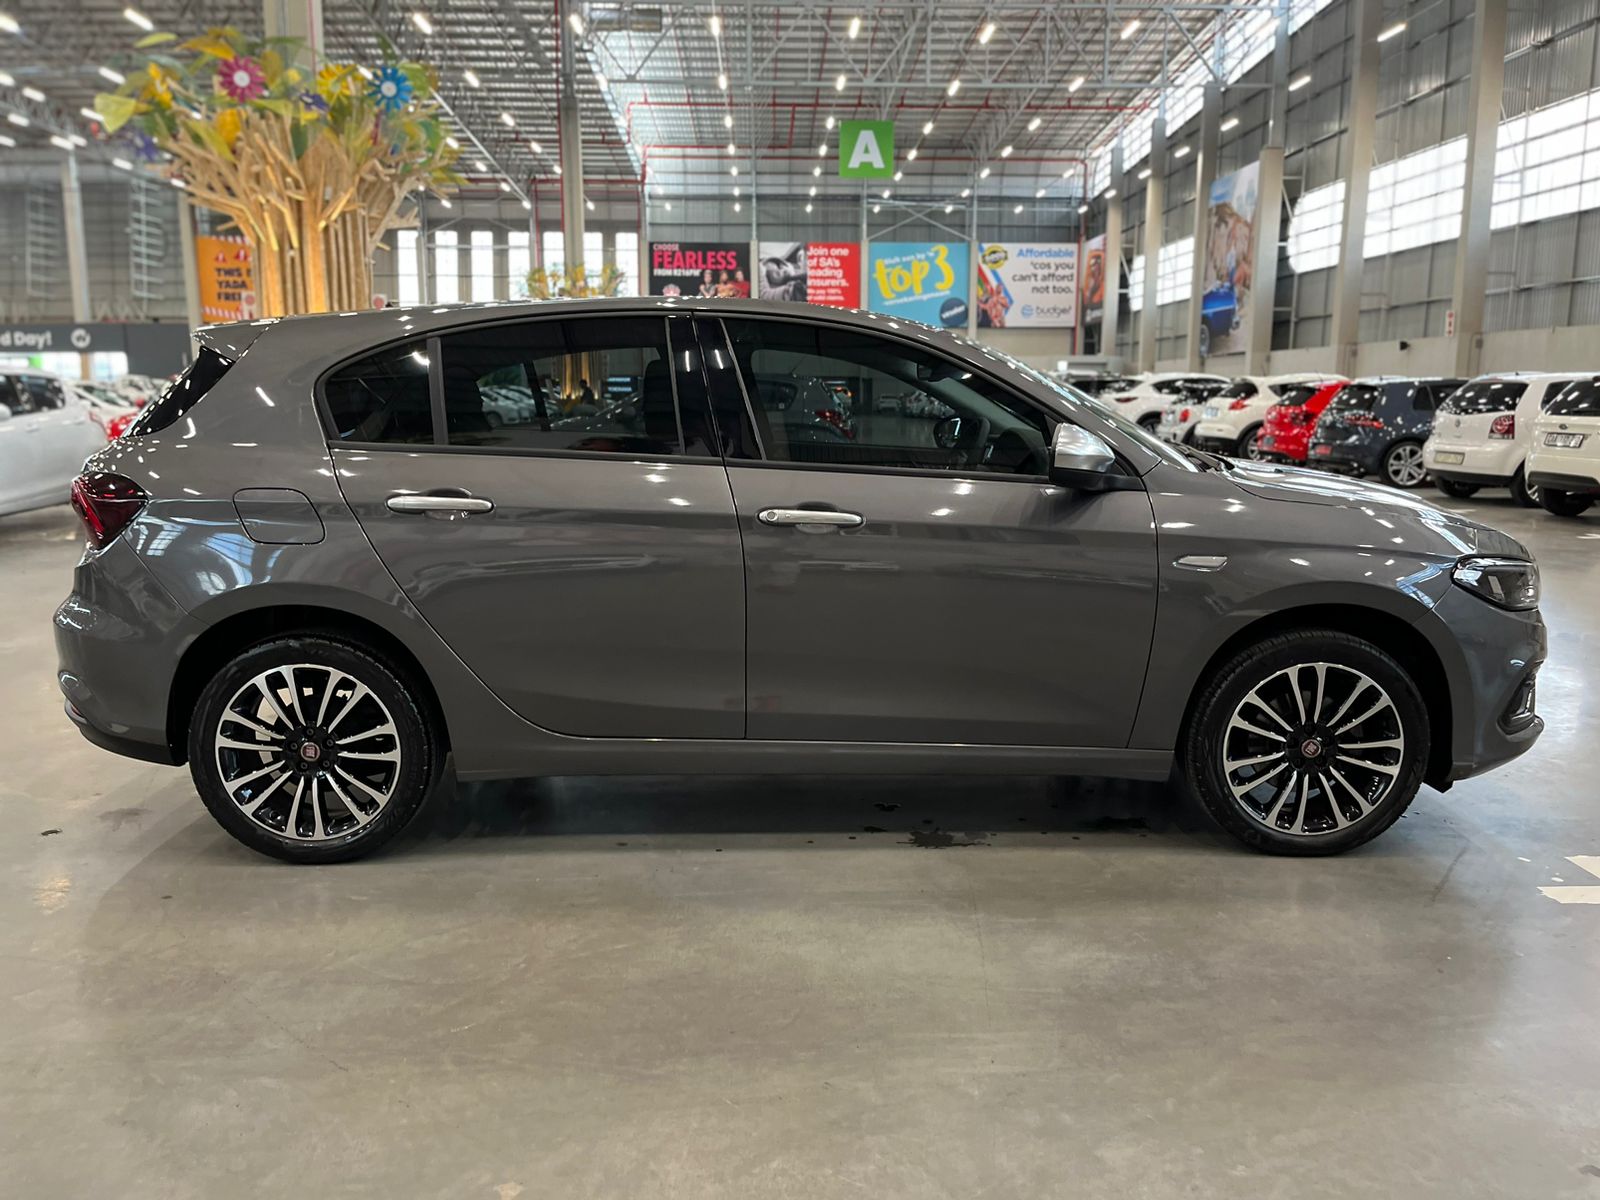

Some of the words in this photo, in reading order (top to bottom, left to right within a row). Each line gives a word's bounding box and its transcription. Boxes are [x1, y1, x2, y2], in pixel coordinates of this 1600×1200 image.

[848, 130, 886, 168] A
[807, 246, 828, 256] Join
[830, 247, 849, 256] one
[1016, 247, 1075, 258] Affordable
[653, 250, 738, 270] FEARLESS
[807, 257, 818, 267] of
[215, 267, 243, 278] THIS
[872, 258, 930, 299] top
[930, 244, 955, 292] 3
[1055, 262, 1075, 275] you
[1012, 273, 1038, 282] can't
[1042, 272, 1075, 282] afford
[1032, 284, 1051, 294] not
[1053, 284, 1074, 294] too.
[13, 331, 53, 350] Day!
